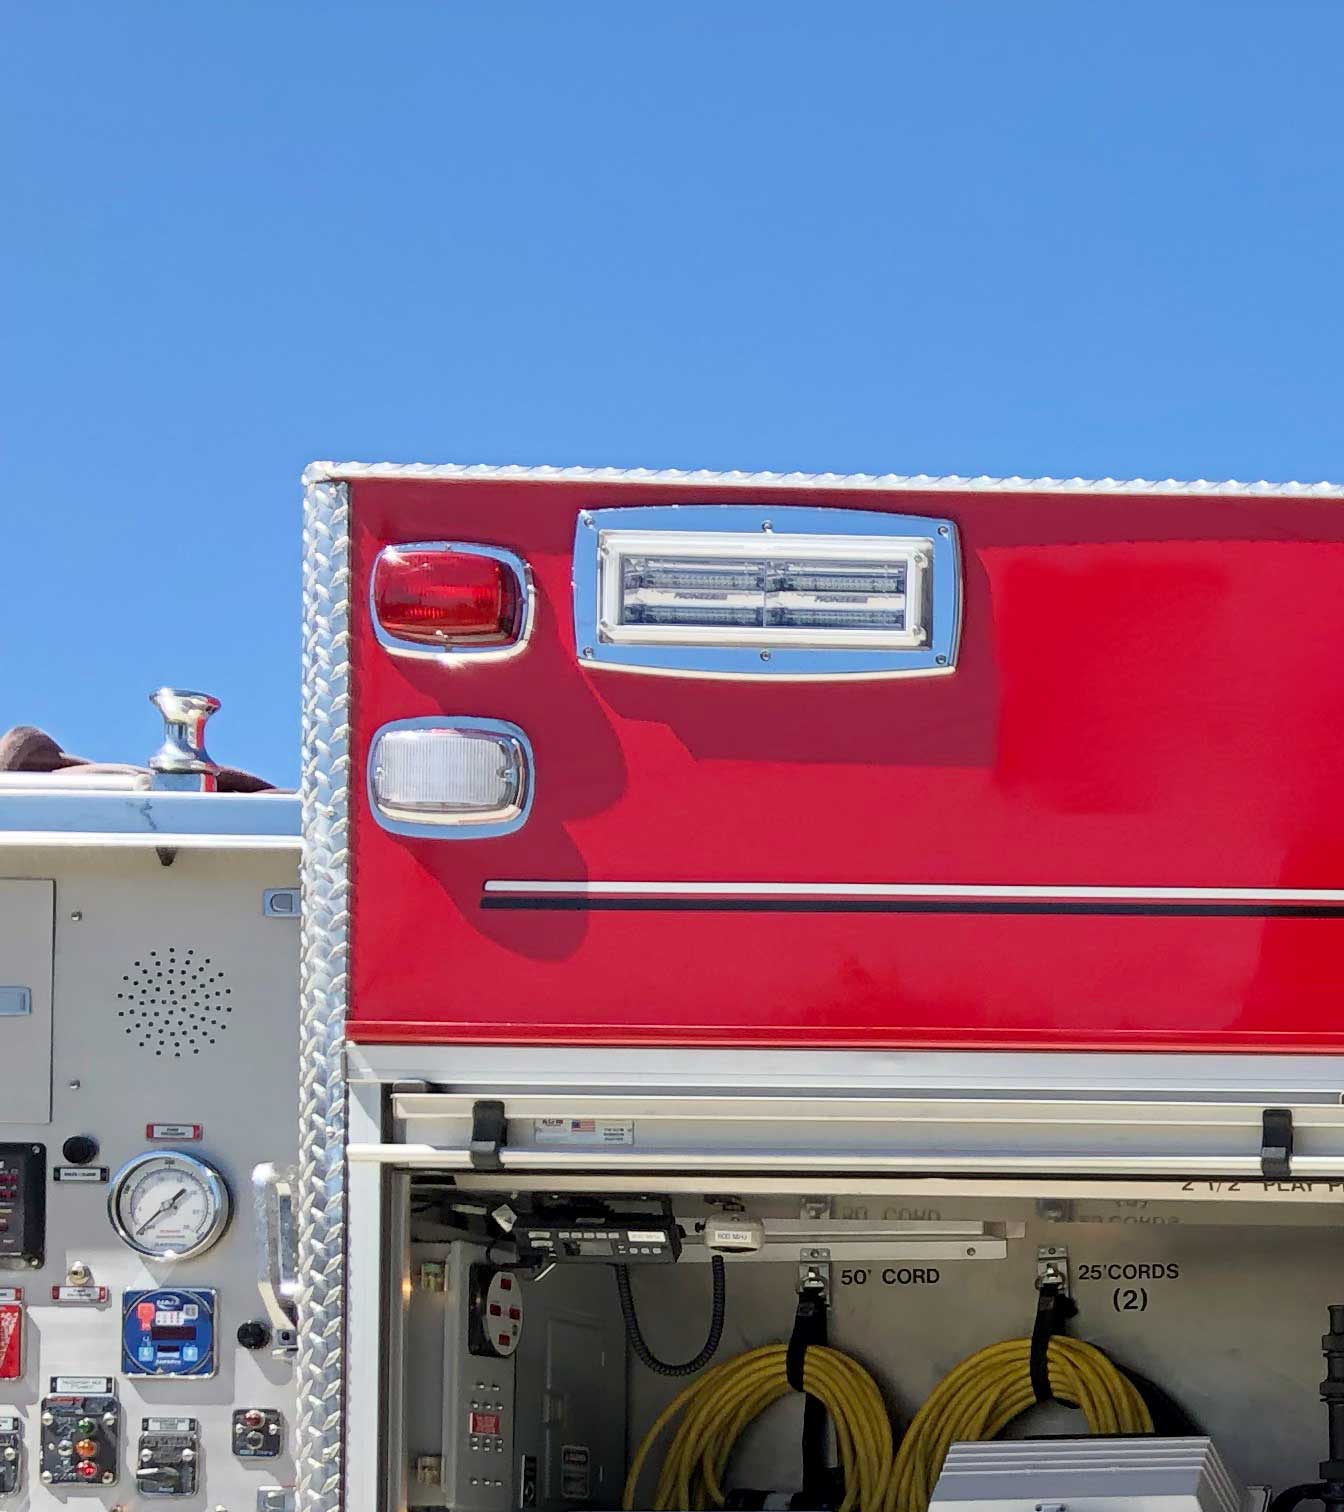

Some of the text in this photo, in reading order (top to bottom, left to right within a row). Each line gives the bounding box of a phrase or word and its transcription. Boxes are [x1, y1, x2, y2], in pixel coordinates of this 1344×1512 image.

[840, 1268, 940, 1286] 50' CORD
[1113, 1287, 1148, 1313] (2)
